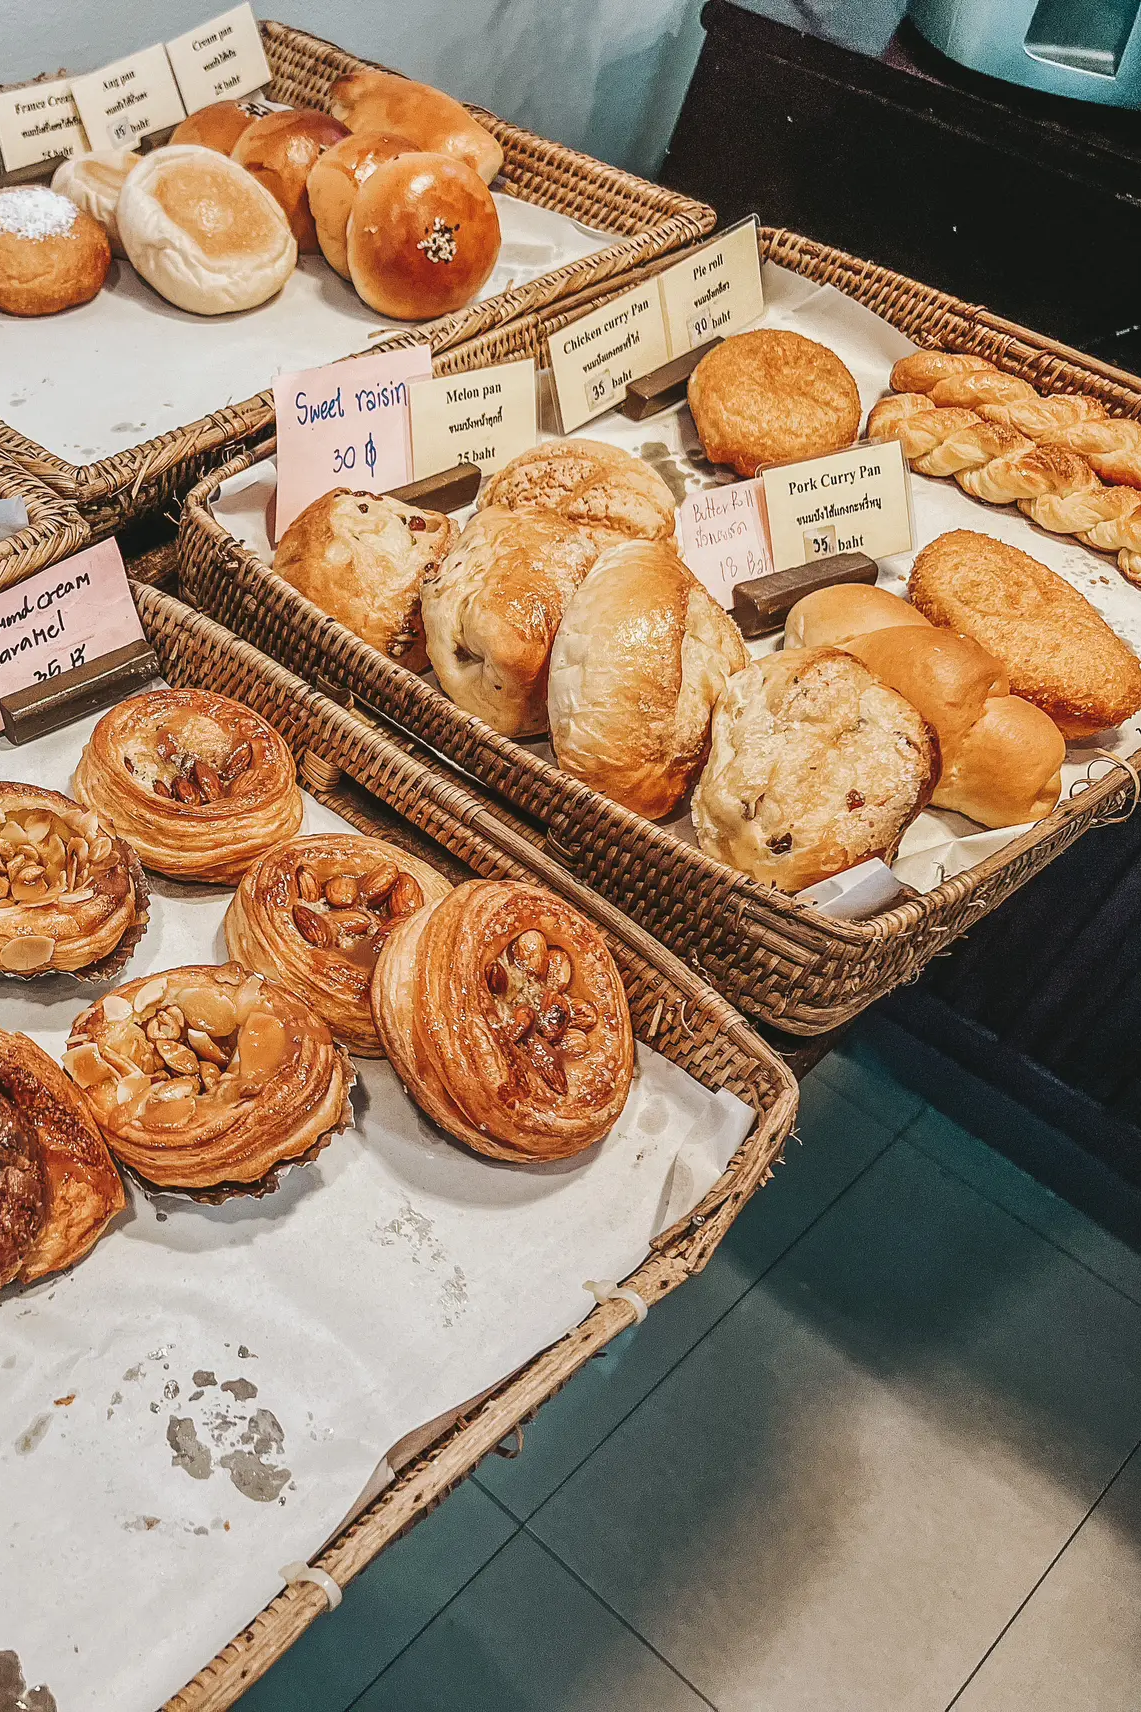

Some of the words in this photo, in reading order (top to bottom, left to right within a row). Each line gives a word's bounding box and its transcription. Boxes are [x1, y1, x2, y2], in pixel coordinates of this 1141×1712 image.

[693, 265, 707, 281] Pie
[708, 253, 724, 272] roll
[563, 326, 602, 355] Chicken
[603, 310, 629, 332] curry
[630, 299, 649, 316] Pan
[711, 309, 731, 329] baht
[446, 387, 479, 404] Melon
[482, 383, 502, 400] pan
[592, 379, 605, 401] 35
[611, 369, 633, 389] baht
[295, 387, 345, 425] Sweet
[355, 381, 408, 413] raisin
[333, 446, 356, 474] 30
[472, 446, 496, 462] baht
[788, 477, 818, 496] Pork
[820, 471, 856, 488] Curry
[859, 465, 881, 480] Pan
[692, 496, 729, 523] Butter
[731, 489, 754, 510] Roll
[837, 534, 864, 552] baht
[720, 556, 738, 582] 18
